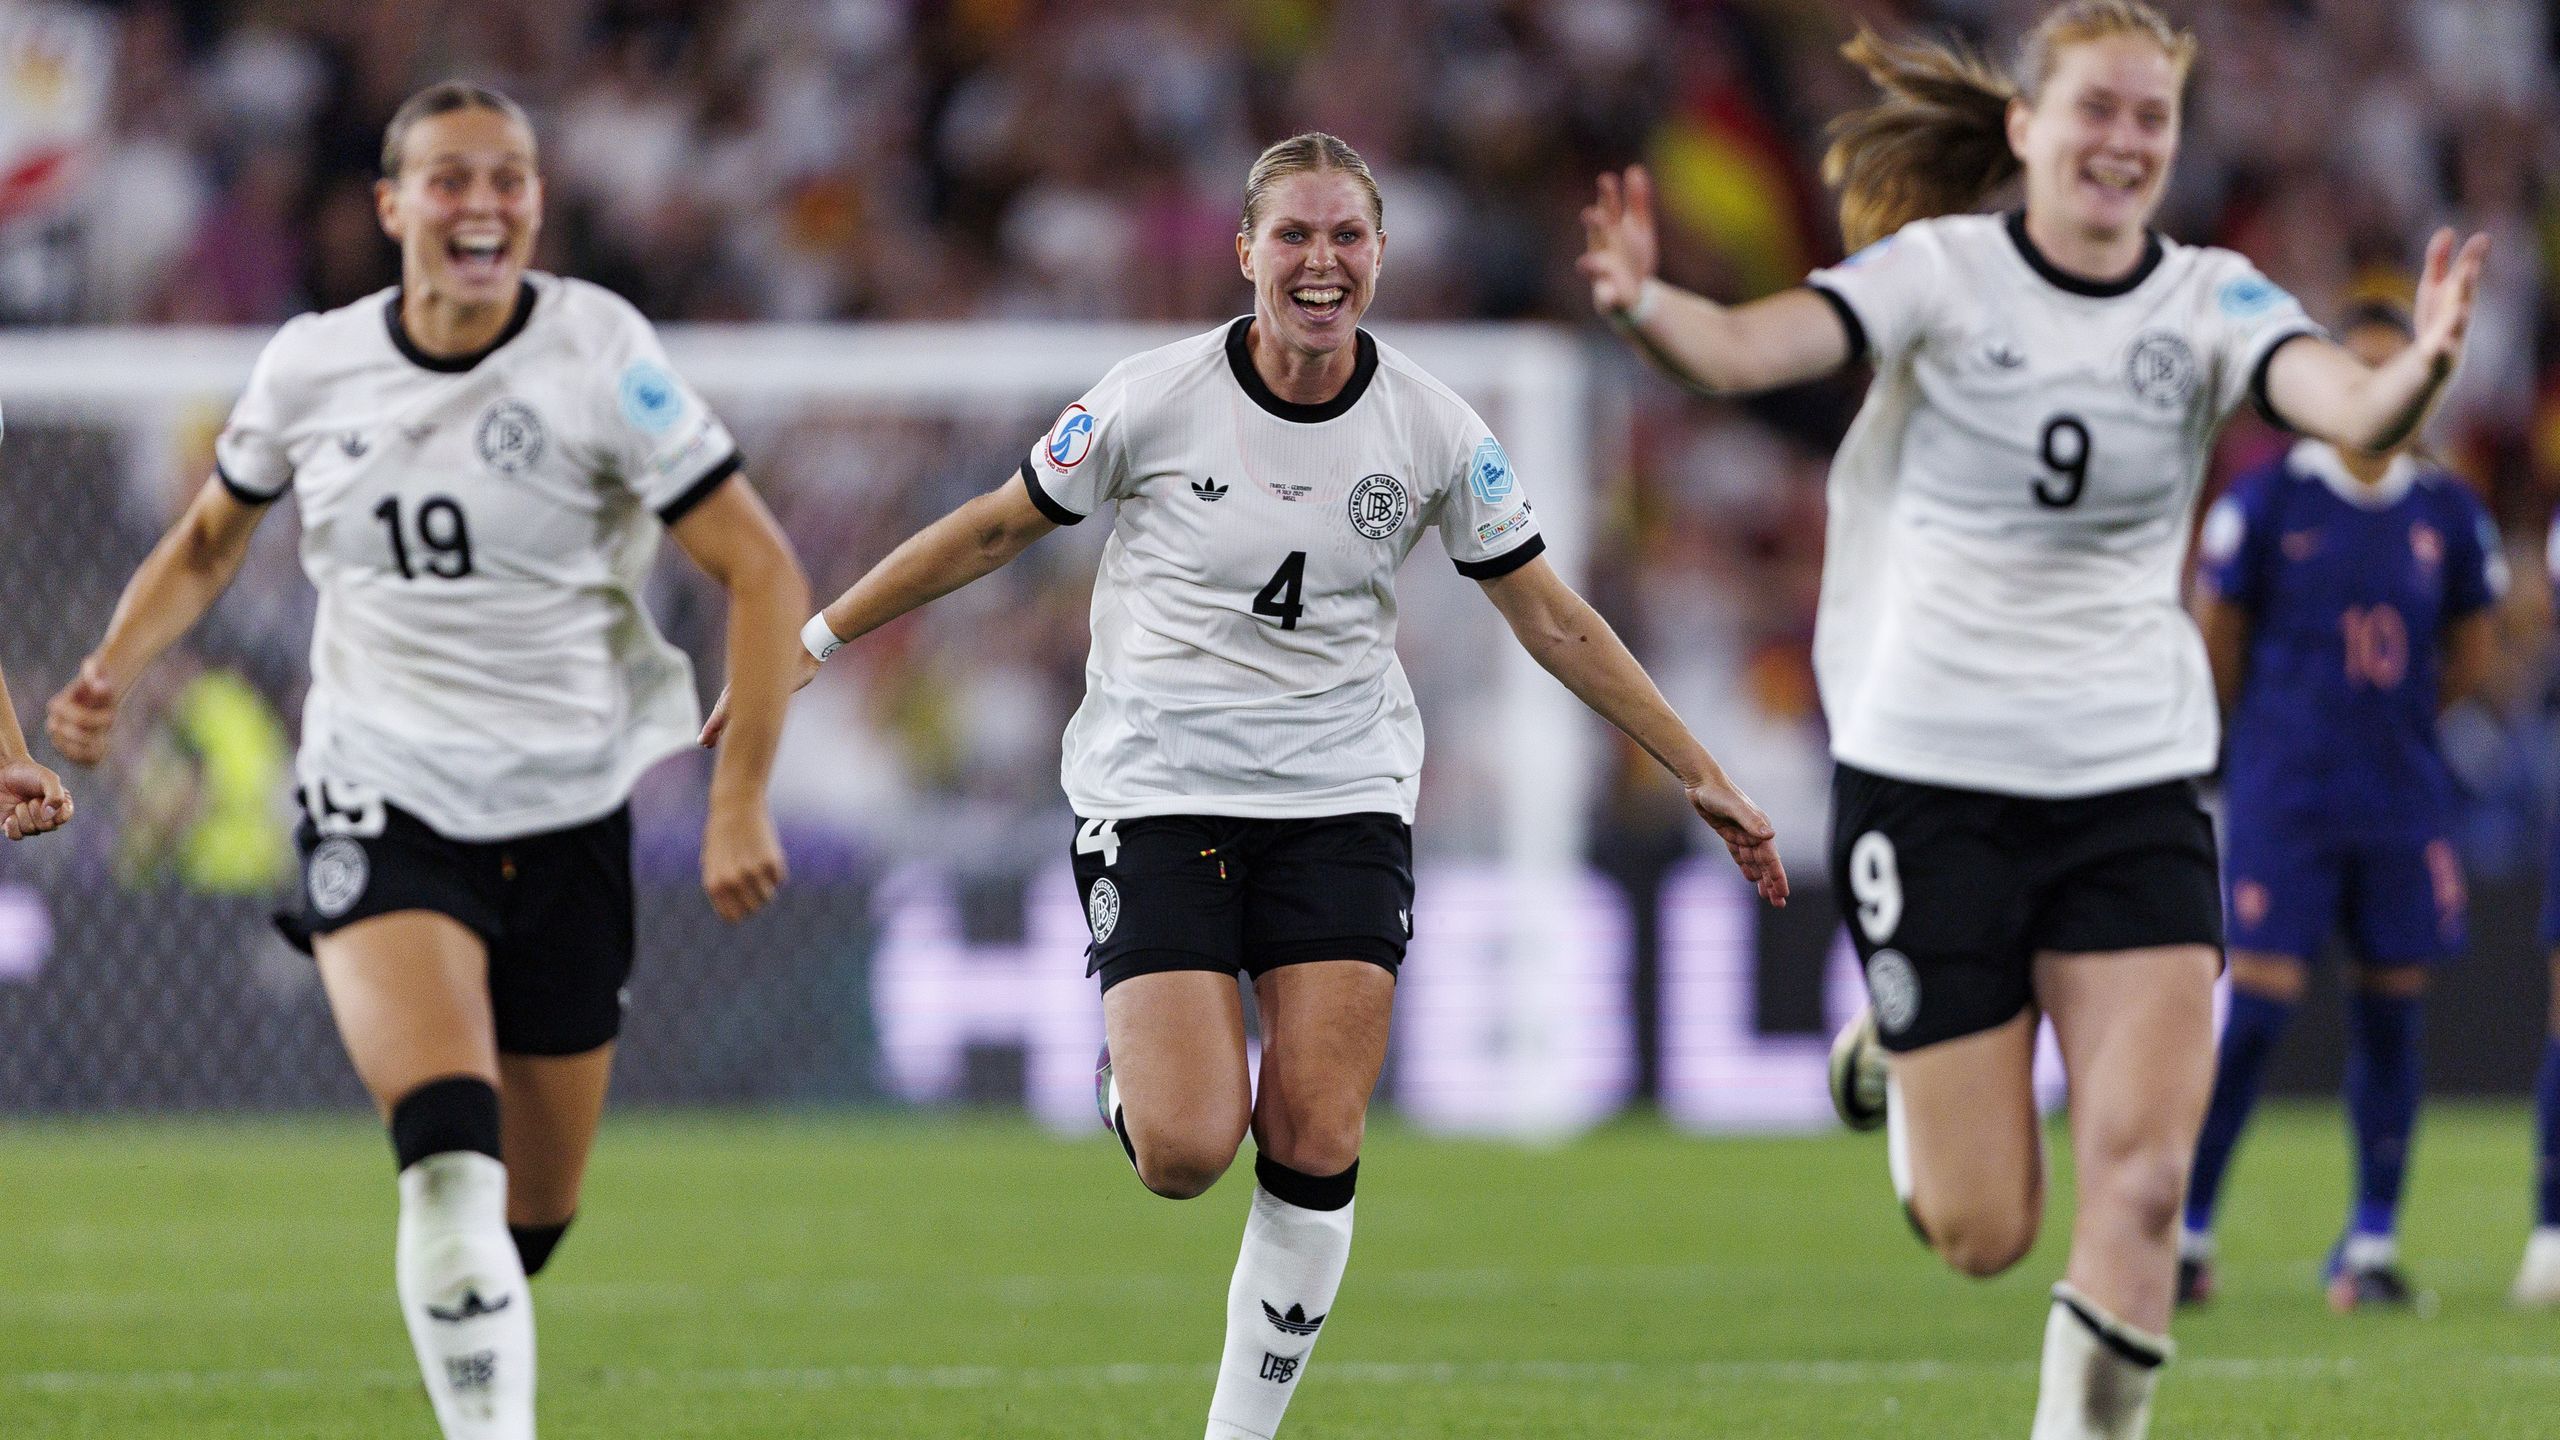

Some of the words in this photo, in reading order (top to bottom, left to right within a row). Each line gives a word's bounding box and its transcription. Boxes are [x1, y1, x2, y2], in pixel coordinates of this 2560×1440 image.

[2033, 415, 2090, 509] 9
[374, 494, 472, 580] 19
[1352, 480, 1371, 529] DEUTSCHER
[1480, 511, 1526, 541] FOUNDATION
[1252, 551, 1307, 630] 4
[2343, 605, 2408, 688] 10
[1076, 818, 1121, 867] 4
[1850, 831, 1903, 945] 9
